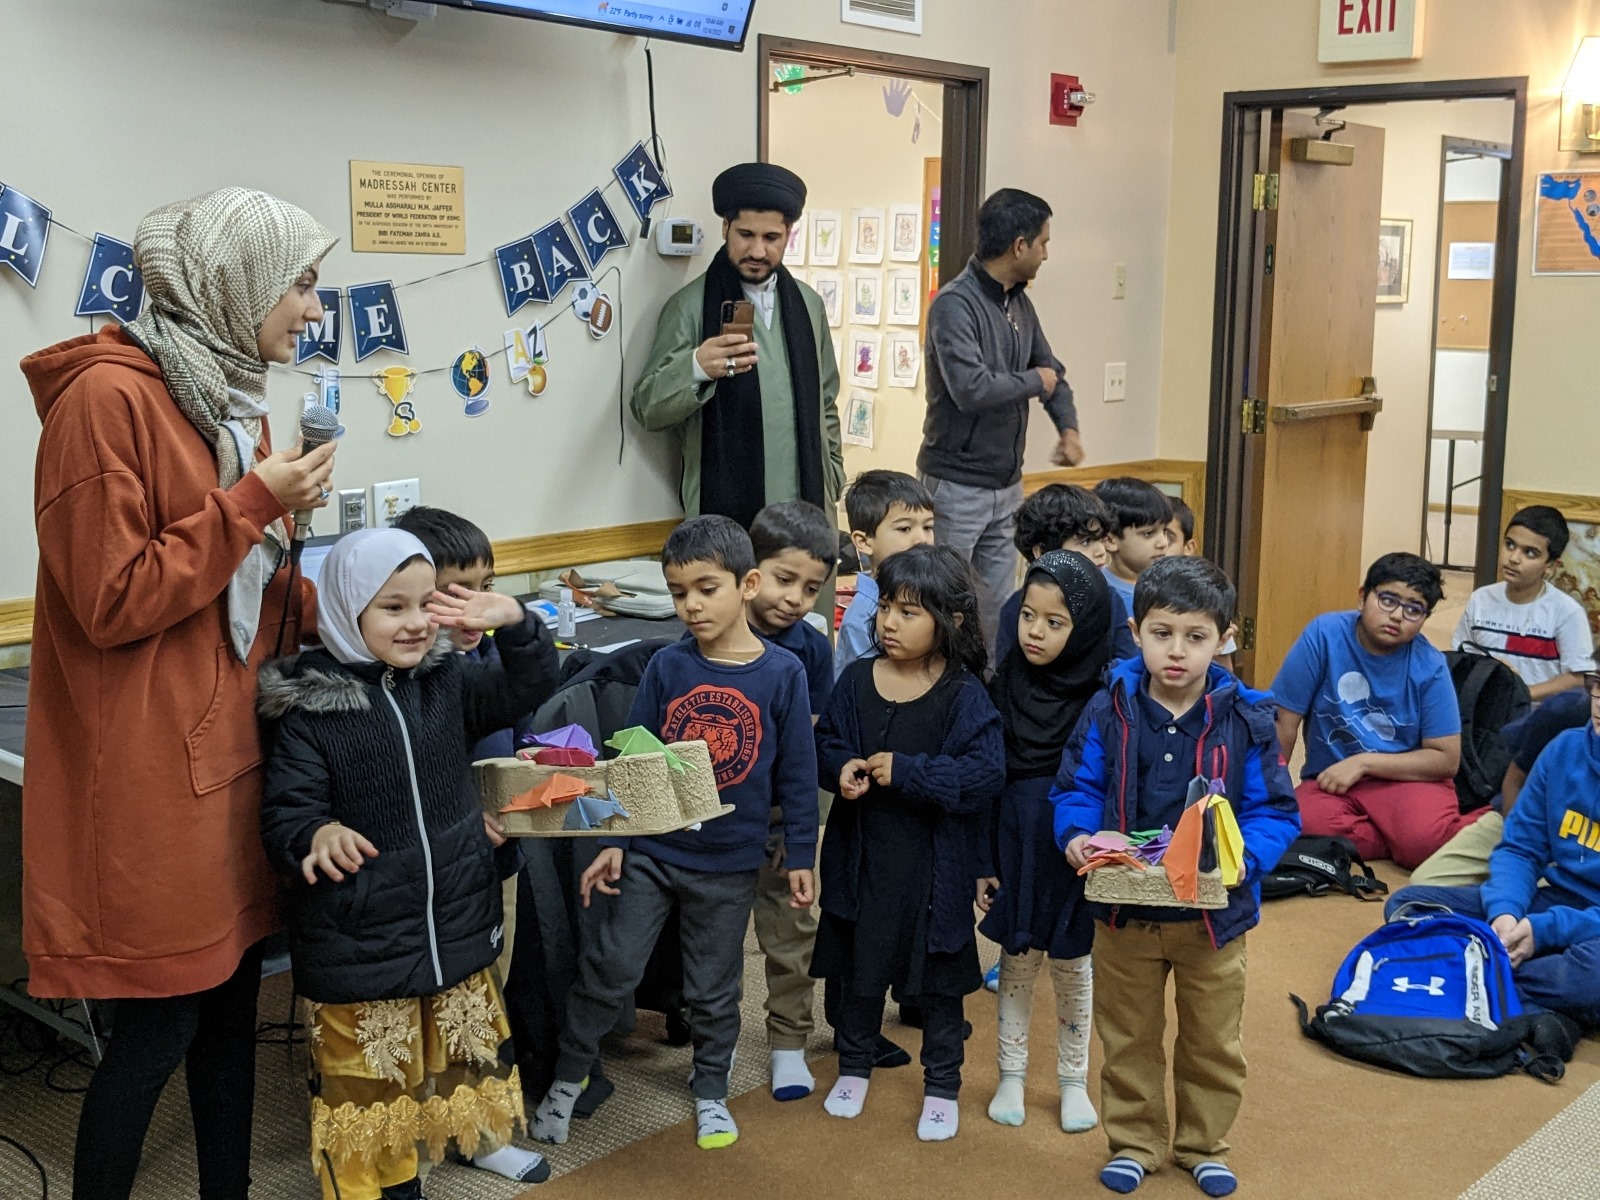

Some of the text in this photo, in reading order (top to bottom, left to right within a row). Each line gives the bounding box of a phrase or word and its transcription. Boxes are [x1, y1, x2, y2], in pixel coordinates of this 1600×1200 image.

[624, 9, 638, 20] Partly
[639, 13, 654, 22] sunny
[372, 169, 382, 177] THE
[383, 170, 415, 178] CEREMONIAL
[416, 172, 437, 180] OPENING
[359, 178, 457, 194] MADRESSAH CENTER
[364, 201, 384, 209] MULLA
[385, 202, 416, 211] ASGHARALI
[432, 204, 453, 212] JAFFER
[409, 213, 438, 221] FEDERATION
[932, 249, 940, 263] 2
[1506, 624, 1547, 636] HILIGER
[670, 691, 755, 761] ATHLETIC ESTABLISHED 1969
